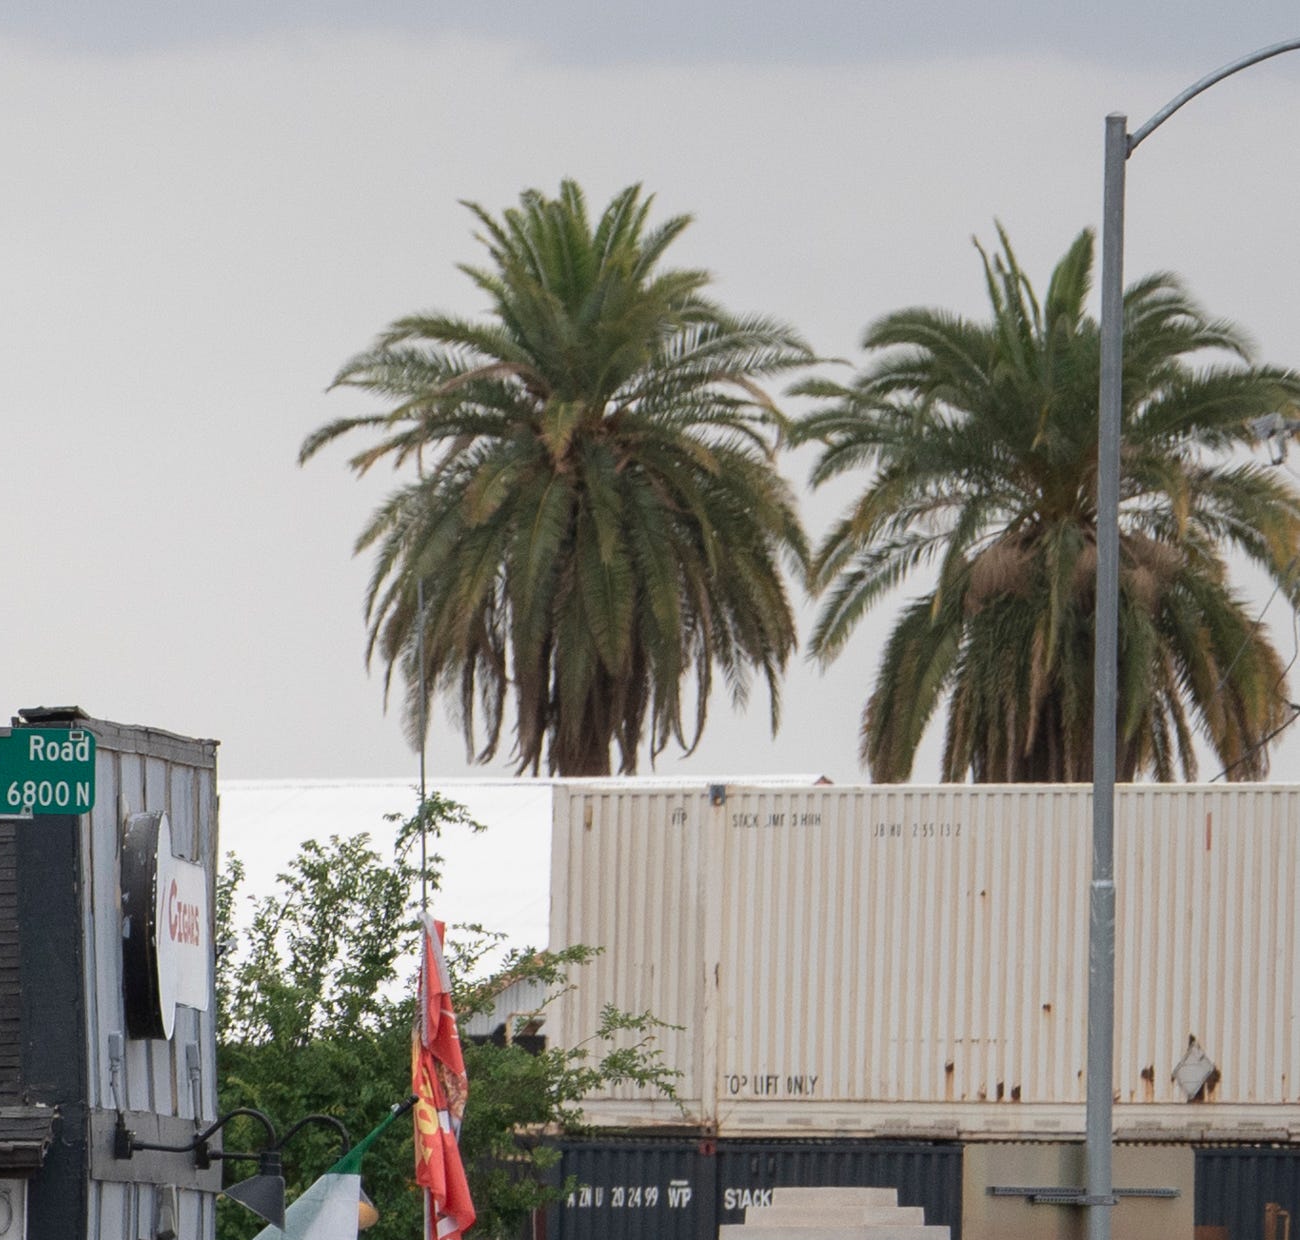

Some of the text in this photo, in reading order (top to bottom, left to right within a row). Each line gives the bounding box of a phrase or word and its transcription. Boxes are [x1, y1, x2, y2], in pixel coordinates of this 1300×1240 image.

[29, 735, 90, 763] Road
[7, 780, 90, 807] 6800 N
[754, 1075, 779, 1095] LIFT
[787, 1075, 818, 1095] ONLY
[724, 1188, 773, 1210] STACK
